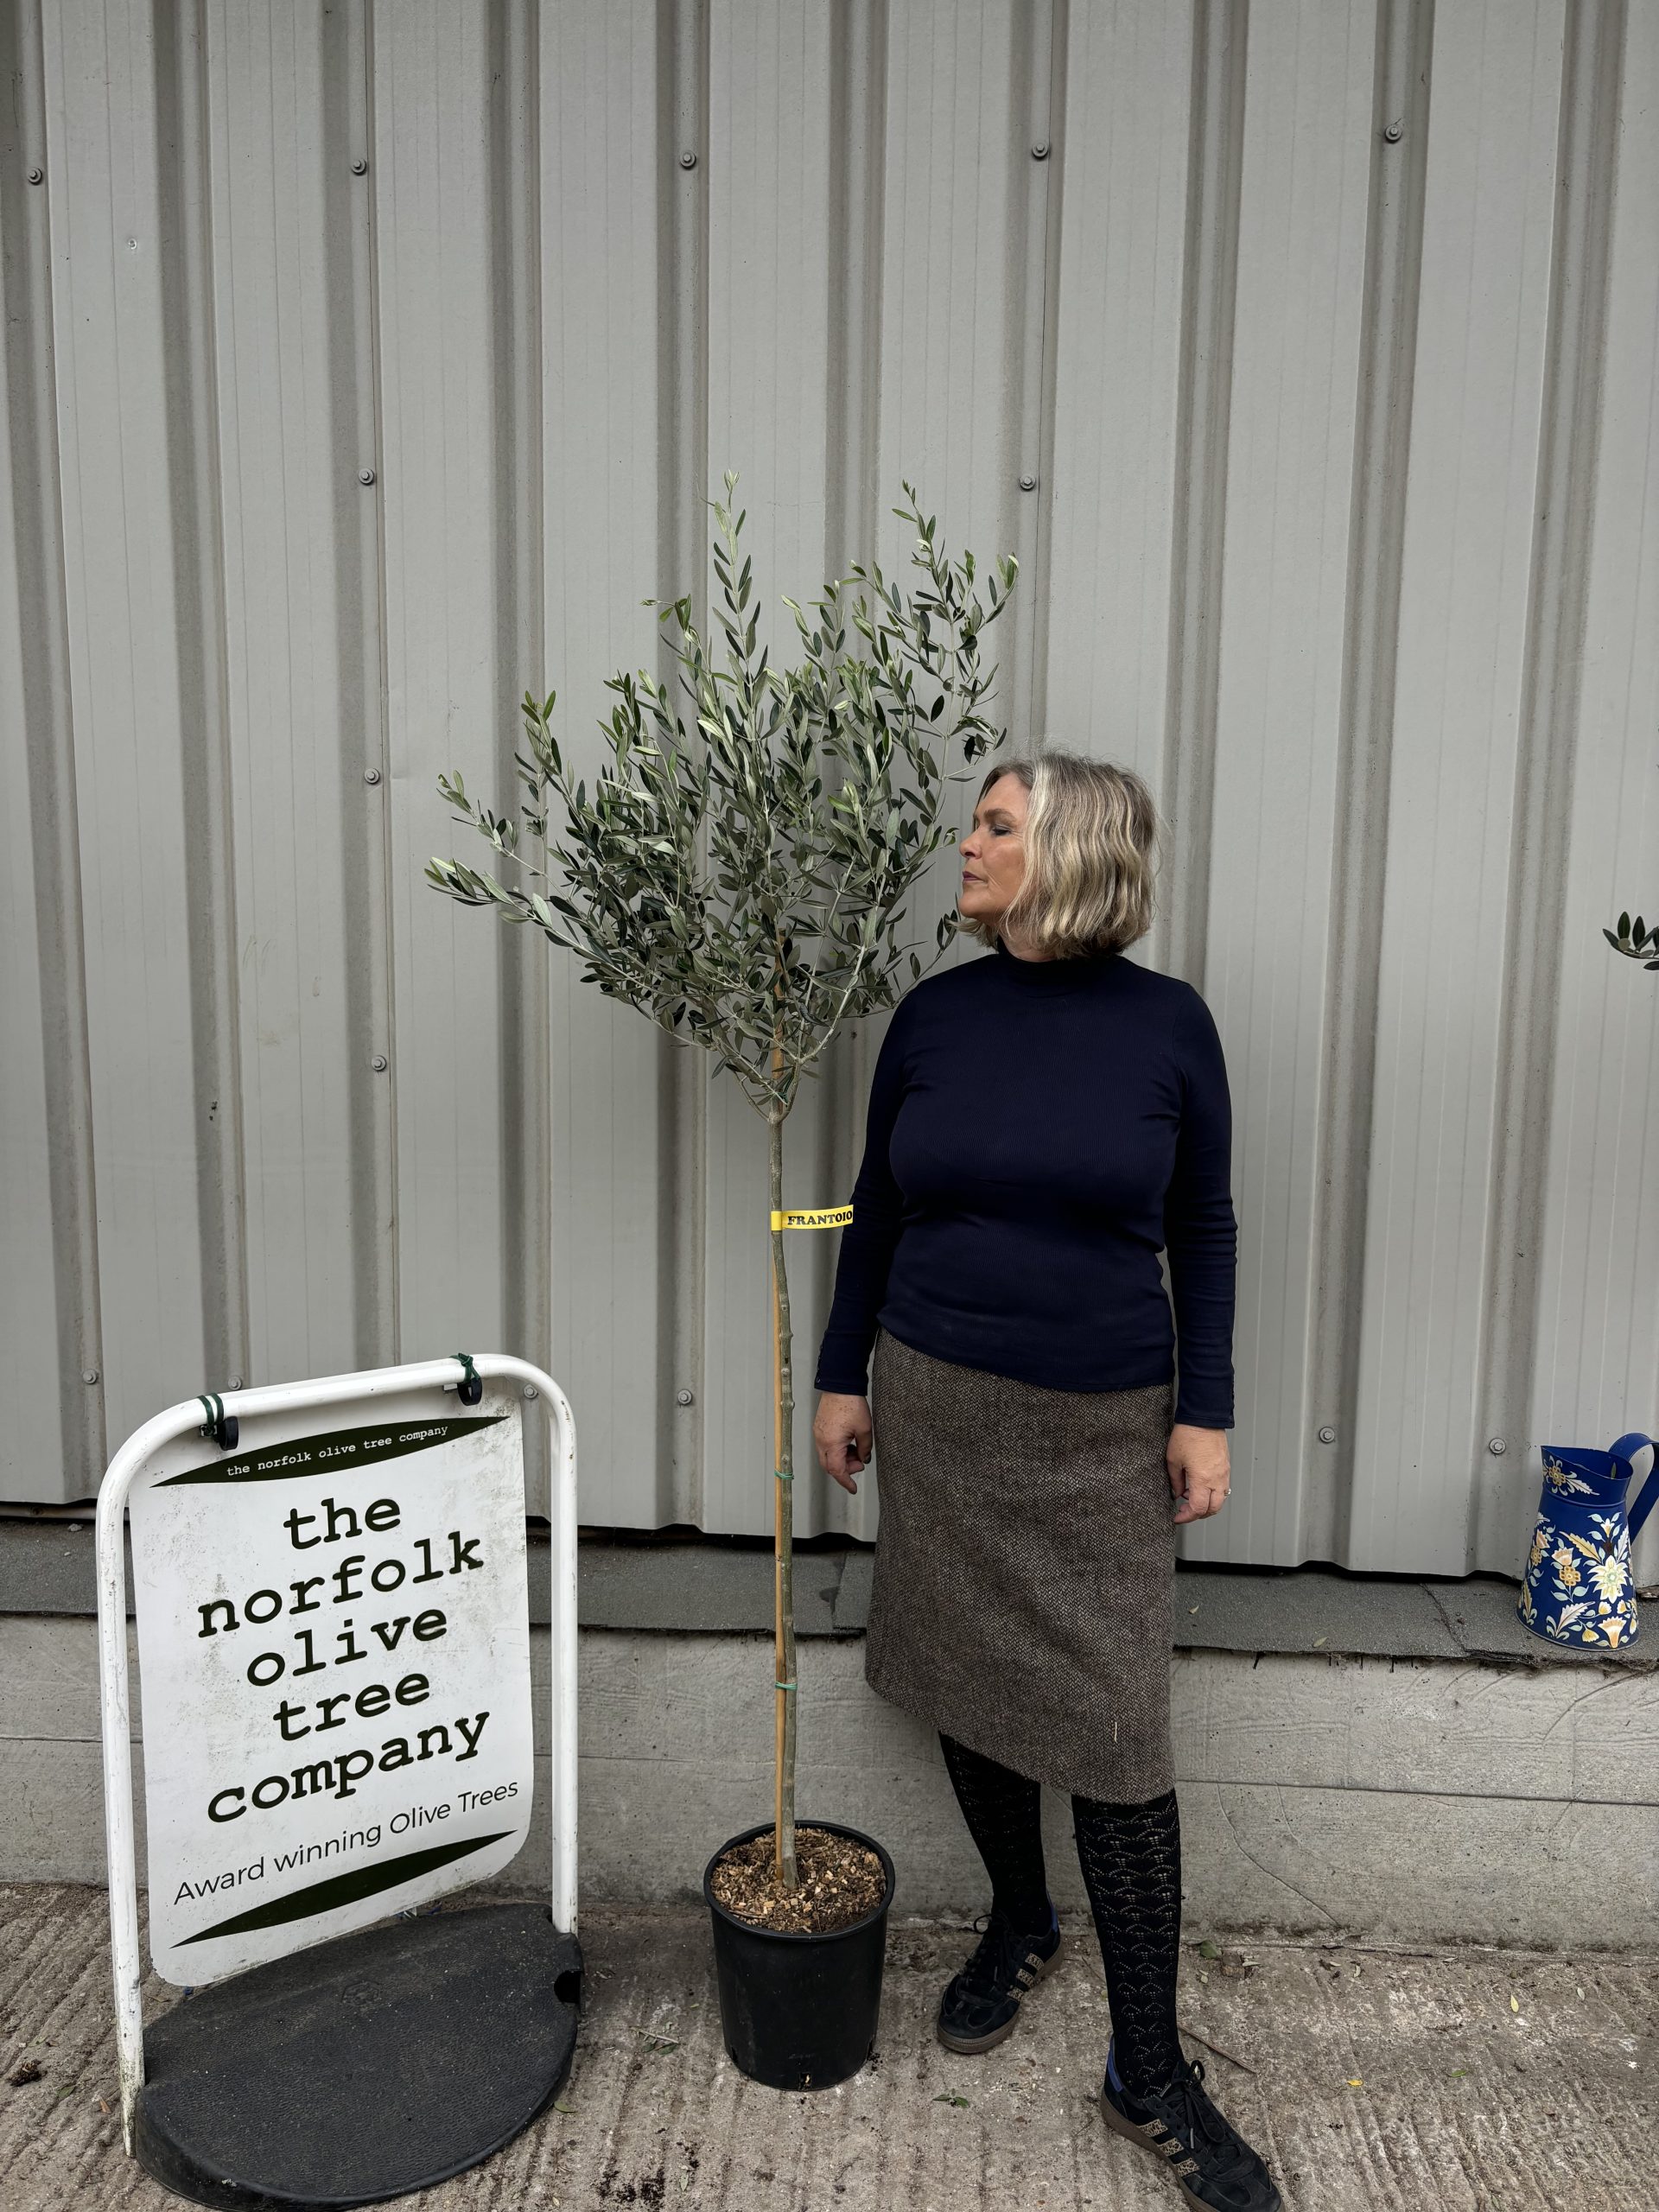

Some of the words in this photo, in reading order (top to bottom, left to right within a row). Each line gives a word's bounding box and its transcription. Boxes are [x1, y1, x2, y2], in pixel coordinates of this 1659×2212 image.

[787, 1211, 852, 1225] FRANTOIO
[227, 1463, 250, 1476] the
[257, 1451, 312, 1471] norfolk
[319, 1445, 356, 1459] olive
[363, 1437, 392, 1450] tree
[399, 1426, 448, 1443] company
[283, 1497, 401, 1550] the
[197, 1530, 485, 1638] norfolk
[246, 1608, 448, 1687] olive
[272, 1673, 430, 1741] tree
[207, 1711, 490, 1823] company
[174, 1857, 265, 1905] Award
[273, 1824, 382, 1875] winning
[390, 1803, 451, 1835] Olive
[457, 1780, 519, 1813] Trees
